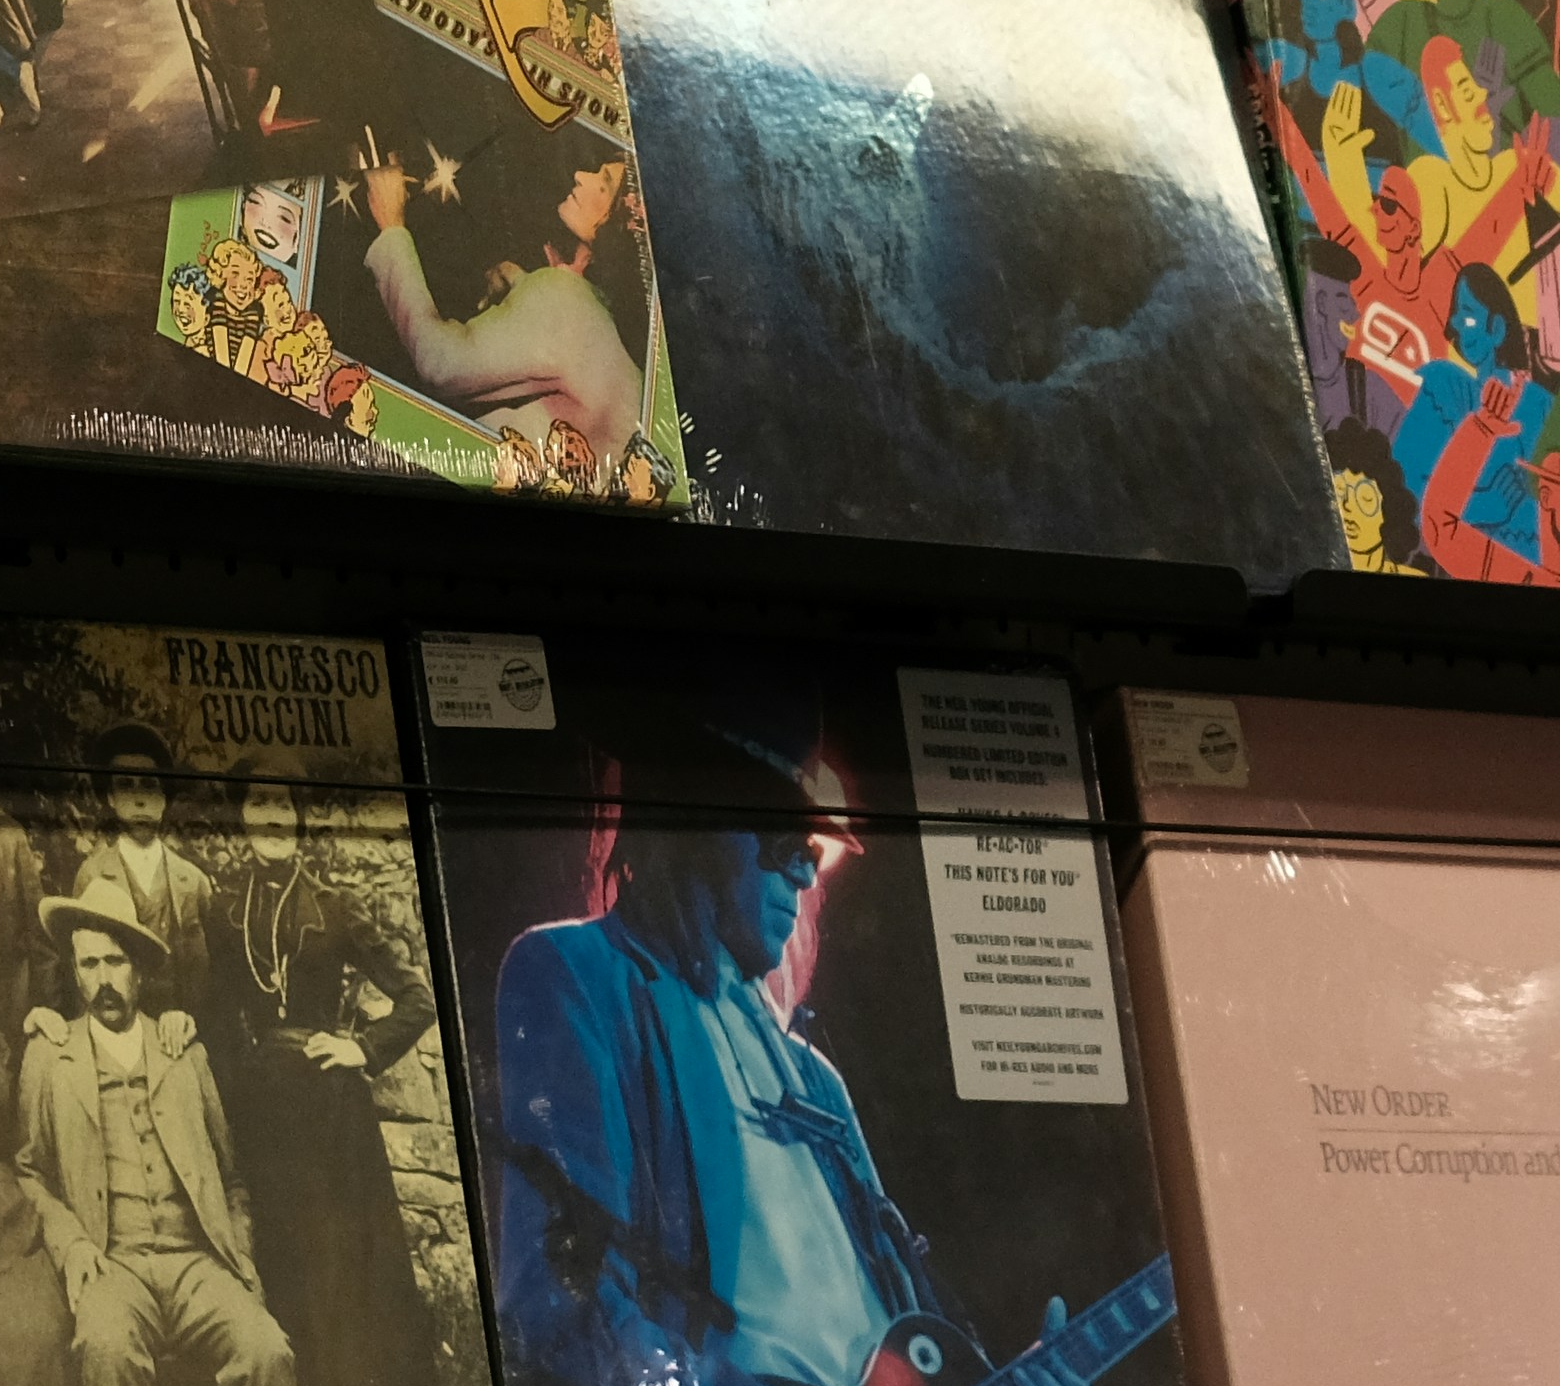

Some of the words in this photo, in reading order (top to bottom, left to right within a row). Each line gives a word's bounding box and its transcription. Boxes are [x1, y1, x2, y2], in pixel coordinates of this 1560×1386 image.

[165, 637, 380, 699] FRANCESCO
[200, 692, 352, 747] GUCCINI
[945, 863, 972, 882] THIS
[977, 865, 1019, 883] NOTE'S
[1024, 867, 1046, 884] FOR
[982, 894, 1047, 914] ELDORADO
[1311, 1083, 1367, 1116] NEW
[1371, 1086, 1452, 1119] ORDER
[1320, 1142, 1391, 1175] Power
[1395, 1142, 1518, 1182] Corruption
